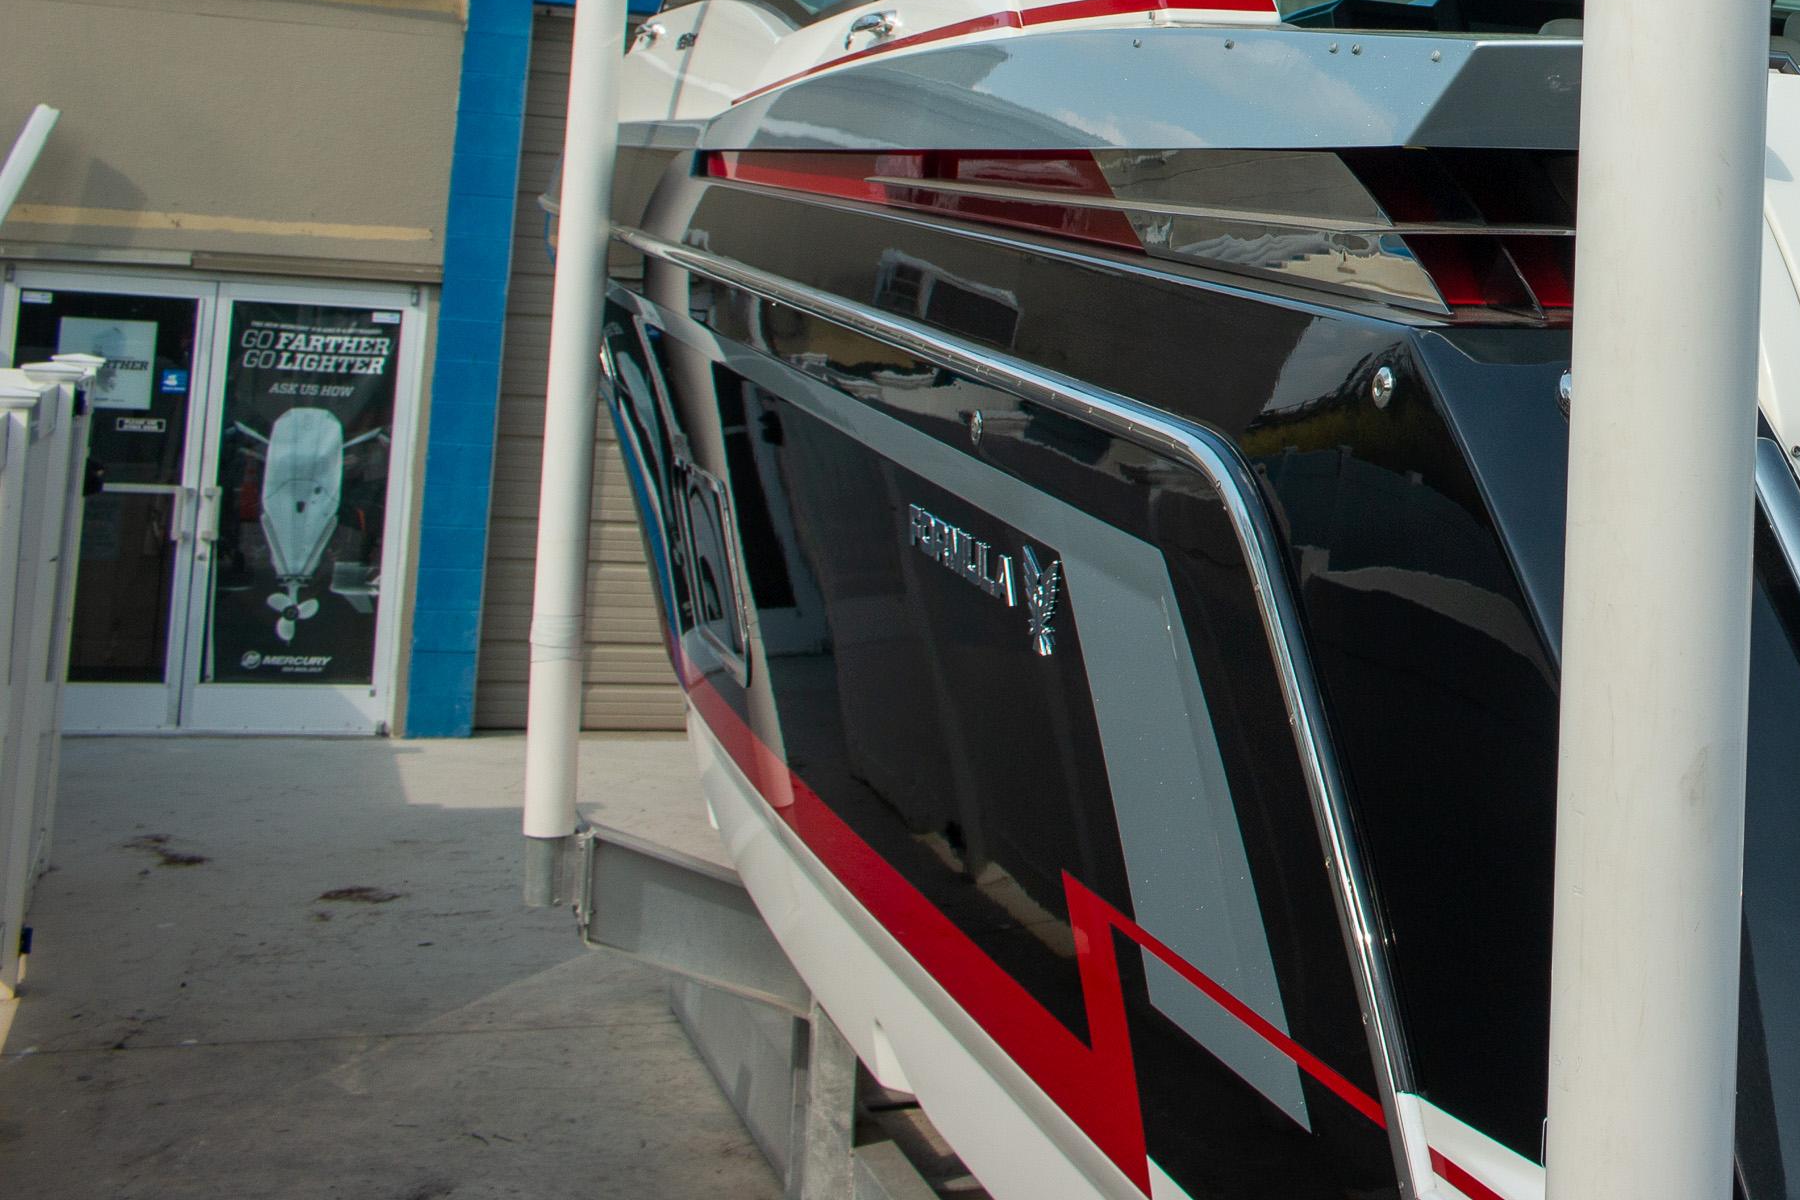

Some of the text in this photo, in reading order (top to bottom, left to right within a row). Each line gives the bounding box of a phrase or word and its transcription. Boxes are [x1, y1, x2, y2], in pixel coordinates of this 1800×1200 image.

[241, 329, 390, 355] GO FARTHER
[243, 350, 385, 375] GO LIGHTER
[269, 382, 354, 397] ASK US HOW
[909, 503, 1017, 607] FORMULA
[262, 655, 332, 666] MERCURY
